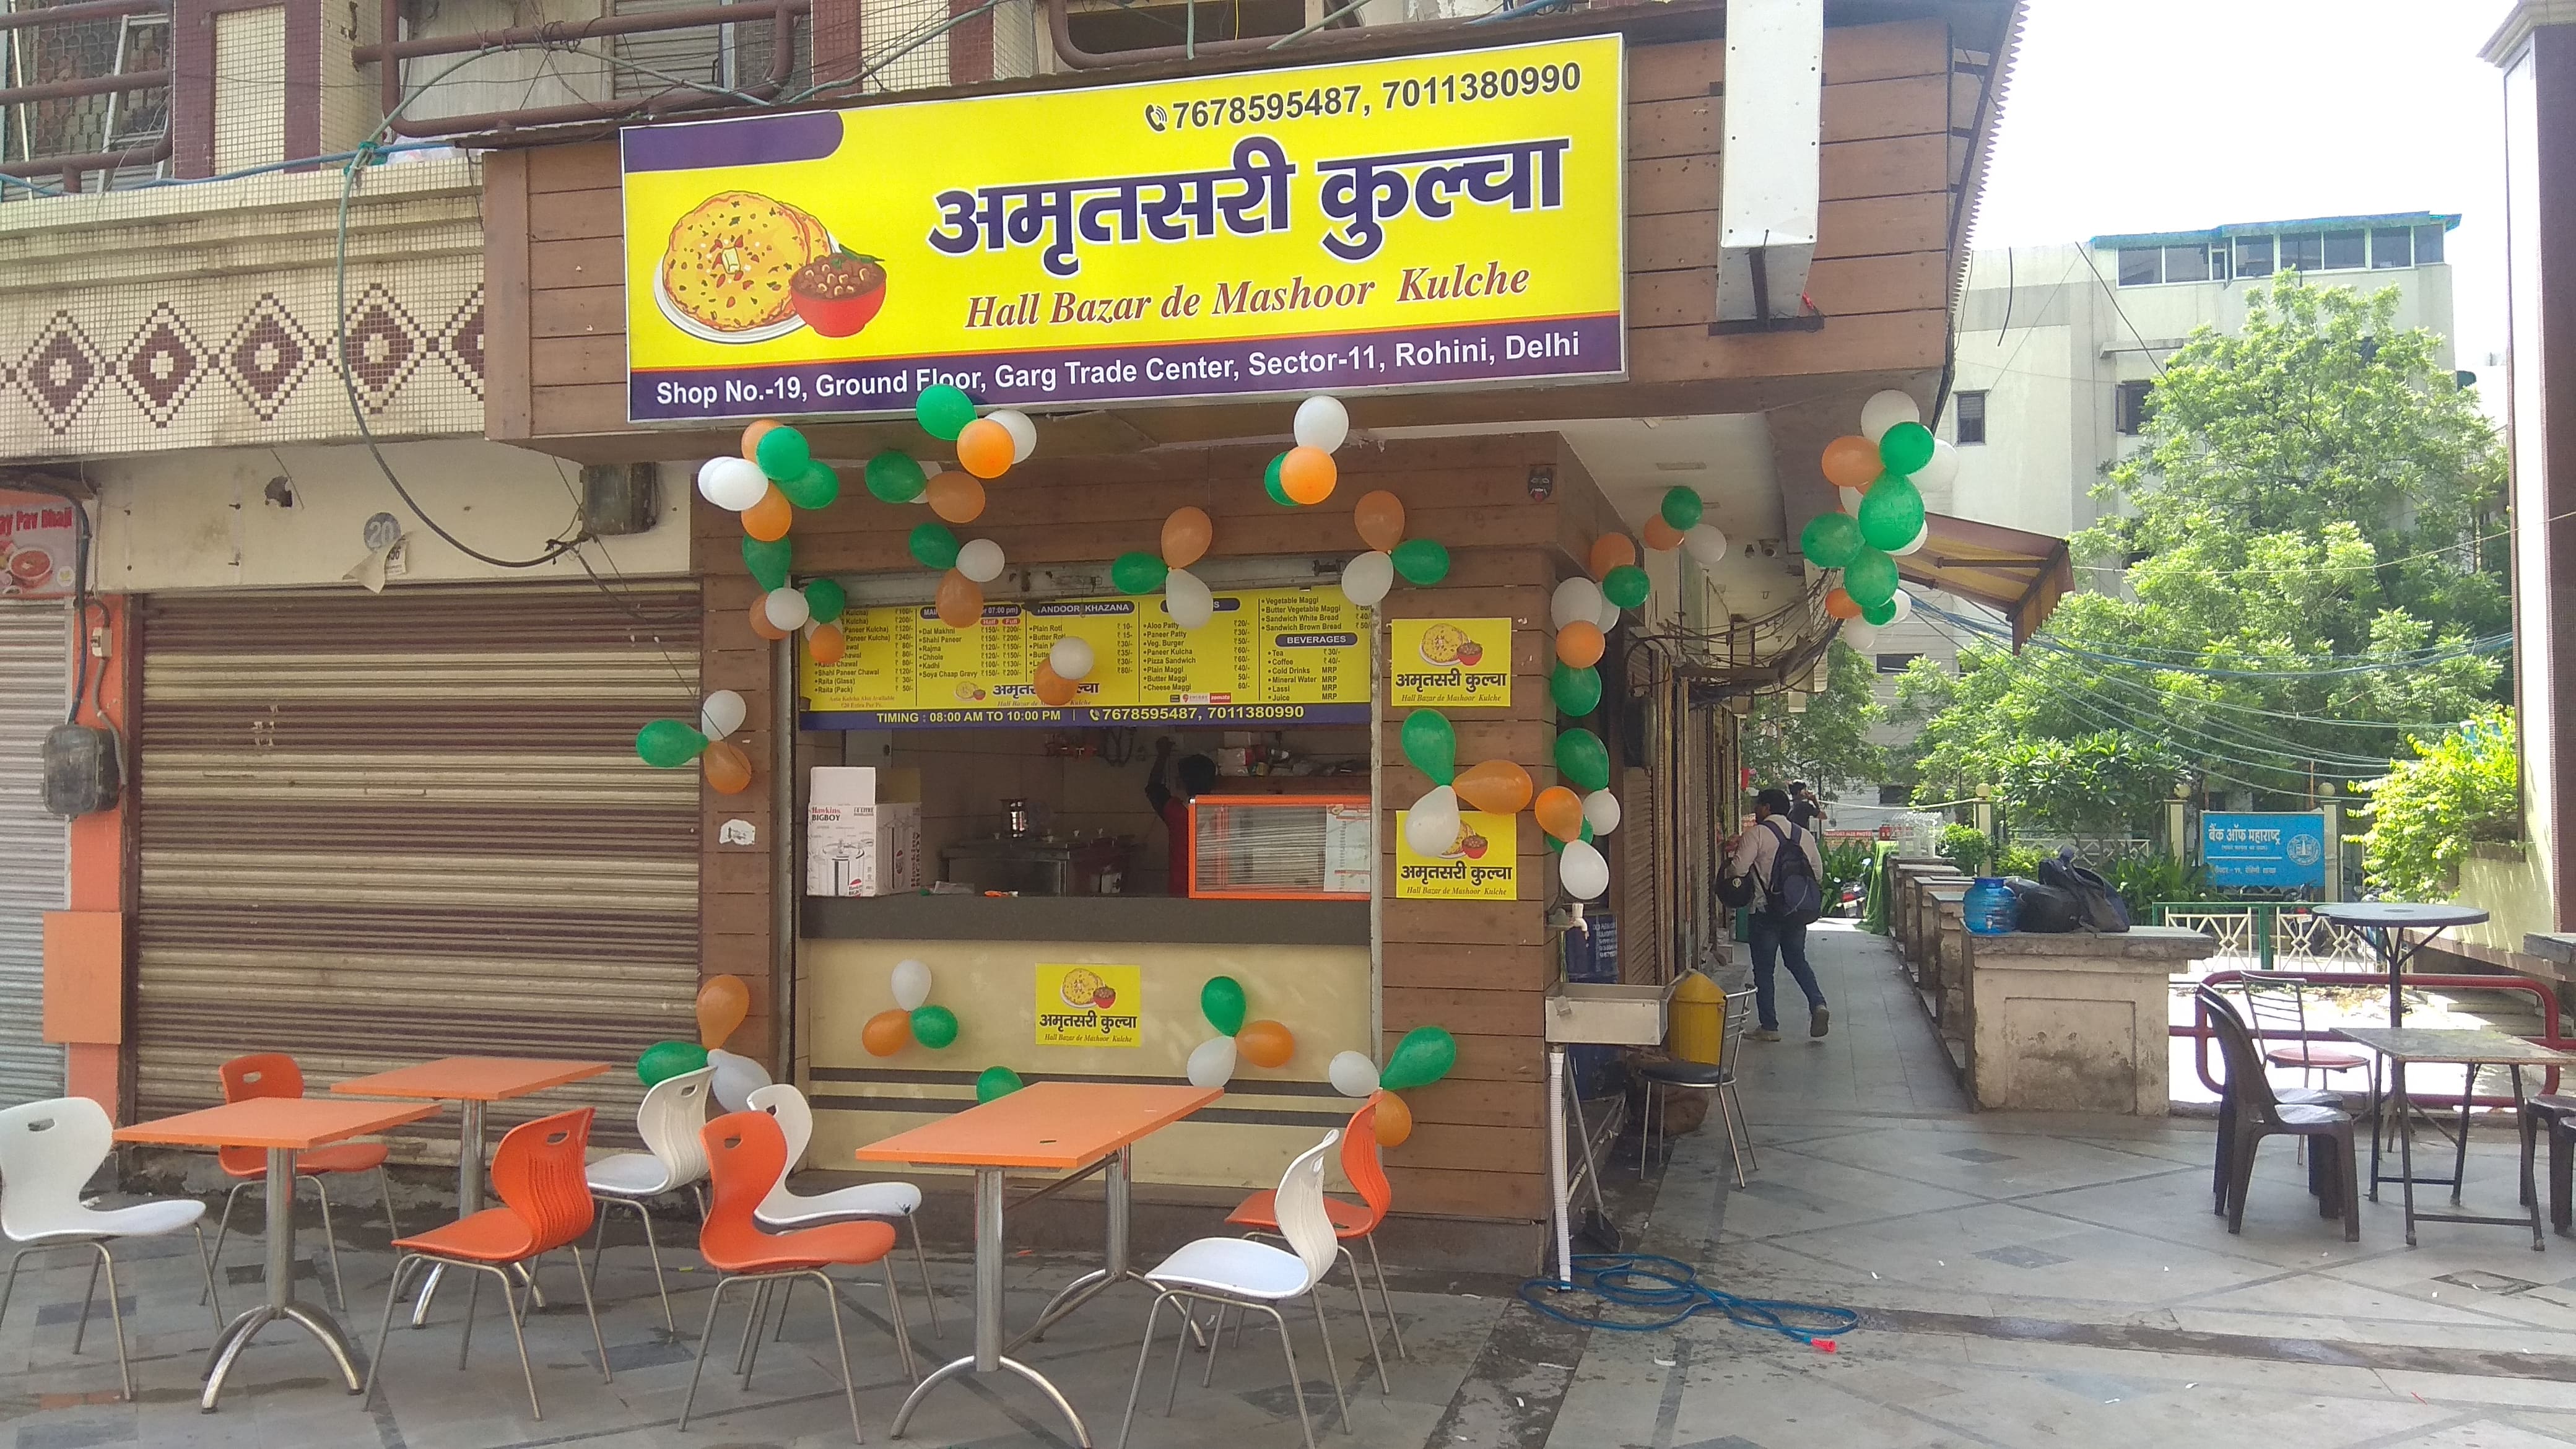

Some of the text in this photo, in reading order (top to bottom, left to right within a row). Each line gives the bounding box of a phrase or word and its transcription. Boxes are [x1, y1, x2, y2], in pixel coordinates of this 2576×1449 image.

[1173, 62, 1580, 129] 7678595487, 7011380990
[929, 136, 1569, 276] अमृतसरी कुल्चा
[965, 261, 1530, 329] Hall Bazar de Mashoor Kulche
[656, 331, 1578, 409] Shop No.-19, Ground Floor, Garg Trade Center, Sector-11, Rohini, Delhi
[367, 521, 394, 547] 20
[1287, 636, 1346, 644] BEVERAGES
[1396, 668, 1507, 692] अमृतसरी कुल्चा
[1417, 694, 1436, 702] Bazar
[877, 712, 919, 723] TIMING
[930, 712, 960, 723] 08:00
[964, 711, 983, 721] AM
[986, 711, 1003, 721] TO
[1007, 711, 1038, 721] 10:00
[1042, 710, 1060, 721] PM
[1102, 708, 1202, 721] 7678595487,
[1208, 707, 1304, 720] 7011380990
[2208, 823, 2280, 845] बैंक ऑफ महाराष्ट्र
[1401, 860, 1512, 886] अमृतसरी कुल्चा
[1423, 887, 1441, 895] Bazar
[1040, 1010, 1137, 1033] अमृतसरी कुल्चा
